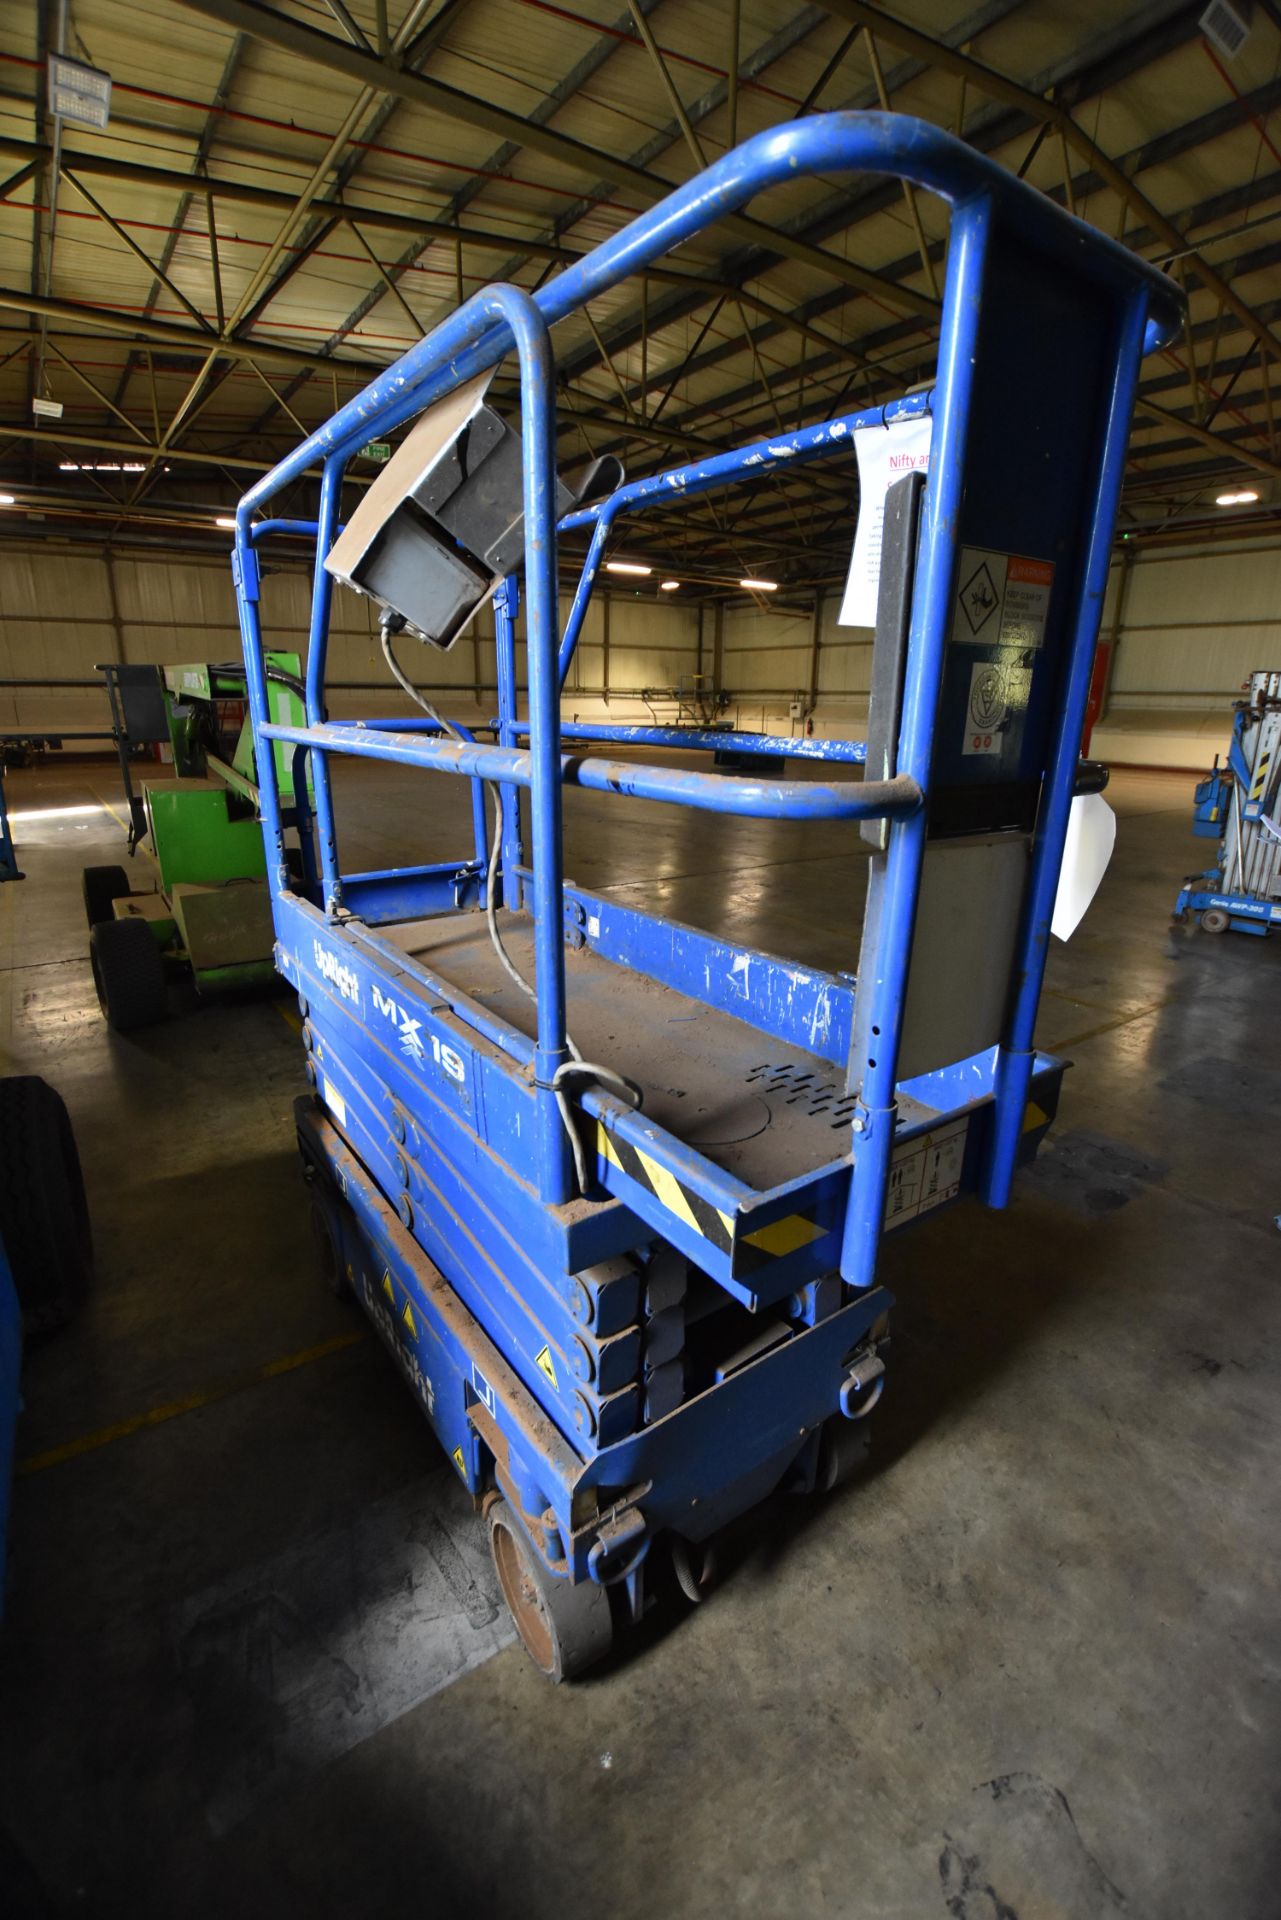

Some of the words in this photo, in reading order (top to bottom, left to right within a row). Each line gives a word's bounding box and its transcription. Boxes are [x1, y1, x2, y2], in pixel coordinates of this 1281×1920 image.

[889, 454, 916, 468] Nifty
[313, 939, 359, 1005] UpRight
[371, 984, 425, 1051] MX
[431, 1034, 465, 1083] 19
